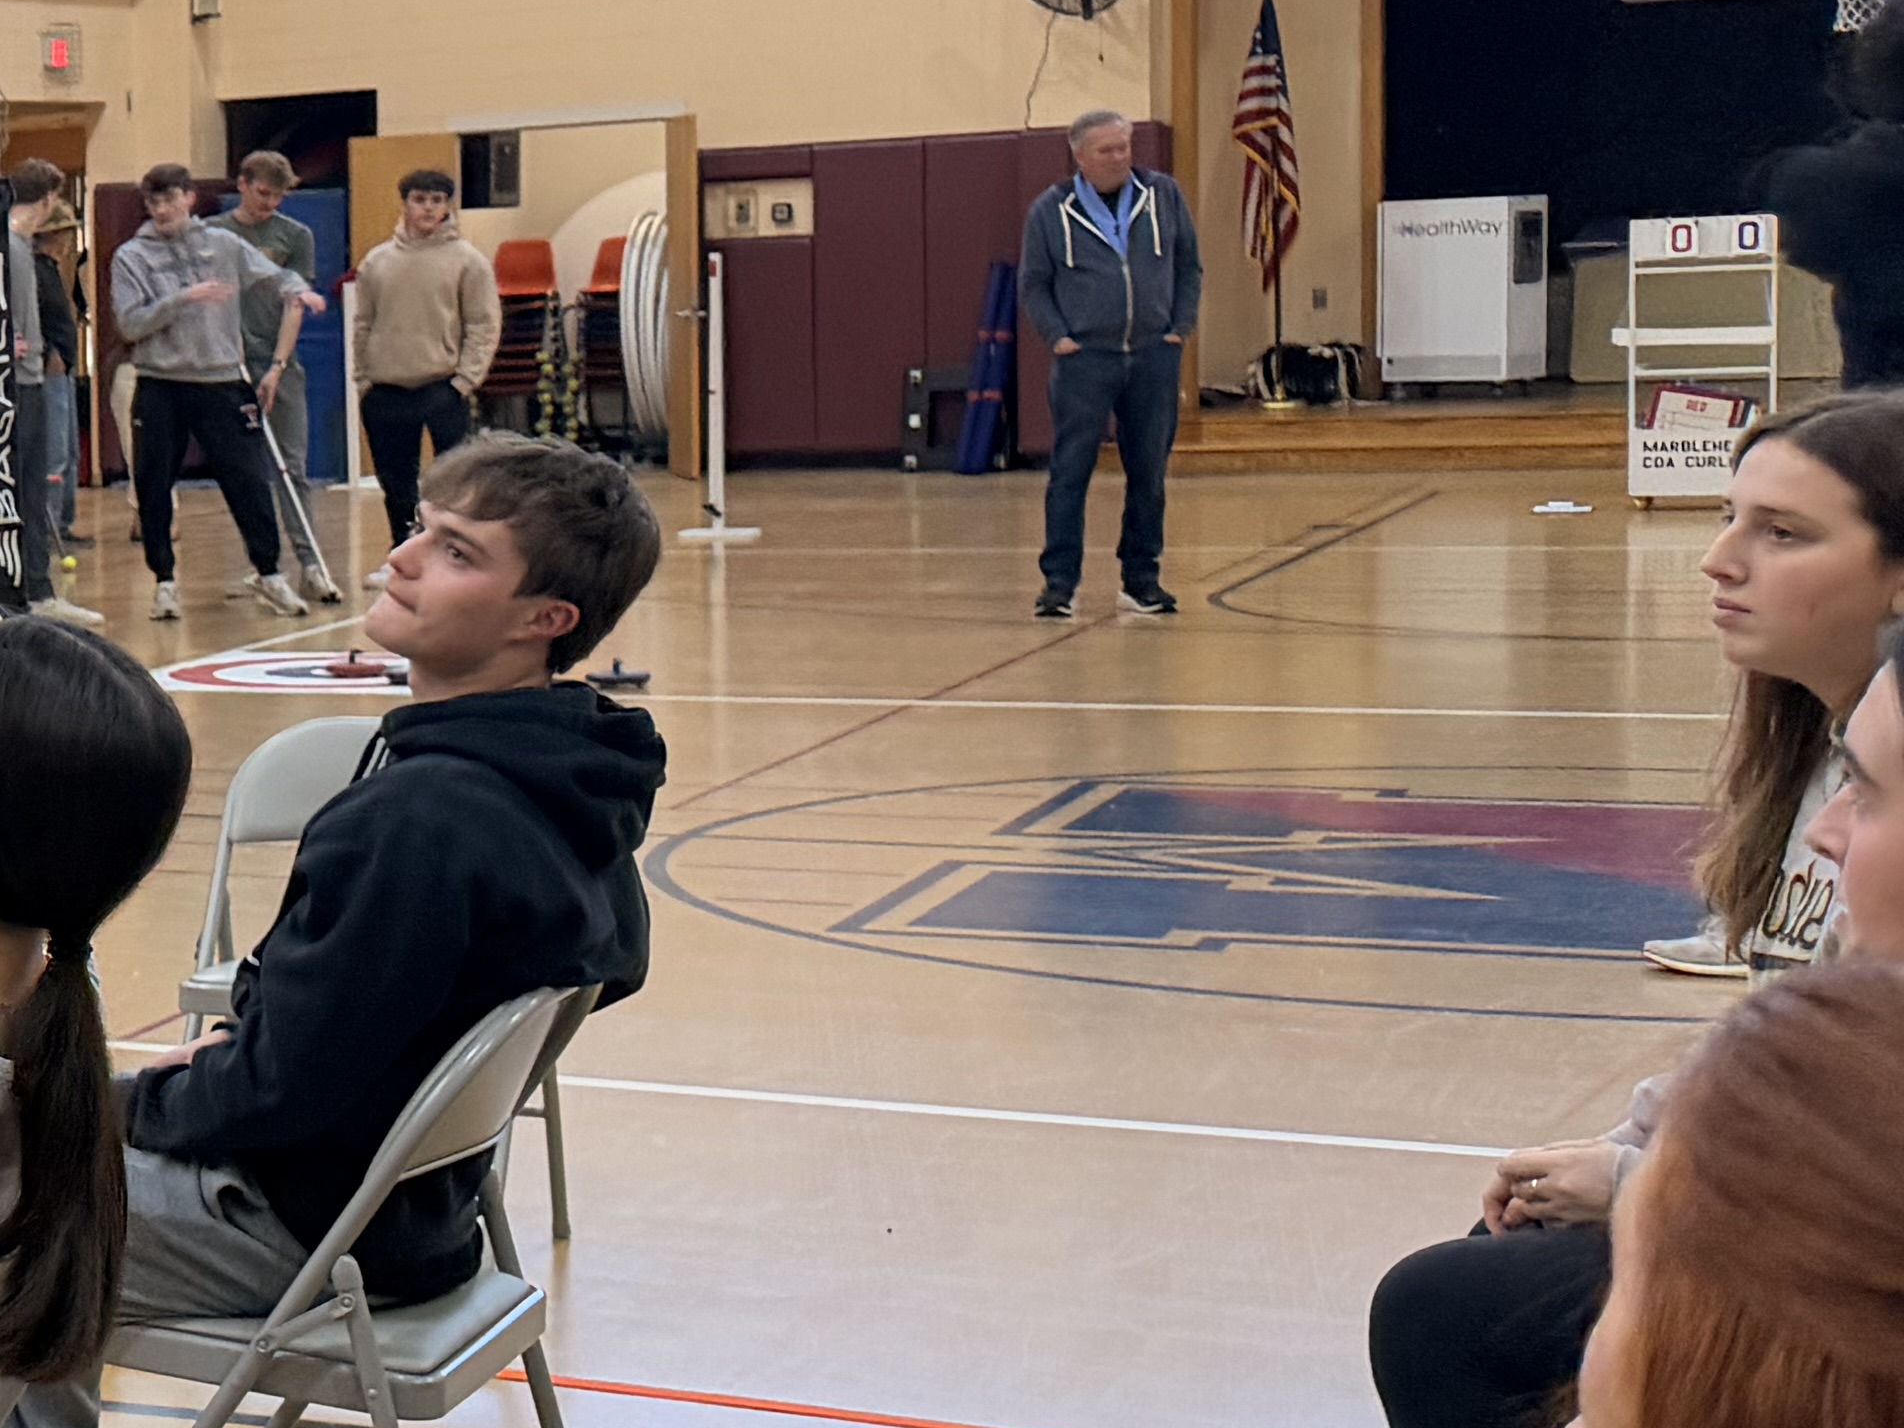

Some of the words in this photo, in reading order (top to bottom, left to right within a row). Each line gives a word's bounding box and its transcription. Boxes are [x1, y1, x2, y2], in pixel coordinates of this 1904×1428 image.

[1671, 224, 1692, 253] 0
[1738, 221, 1760, 250] 0
[1643, 440, 1733, 453] MARBLEHE
